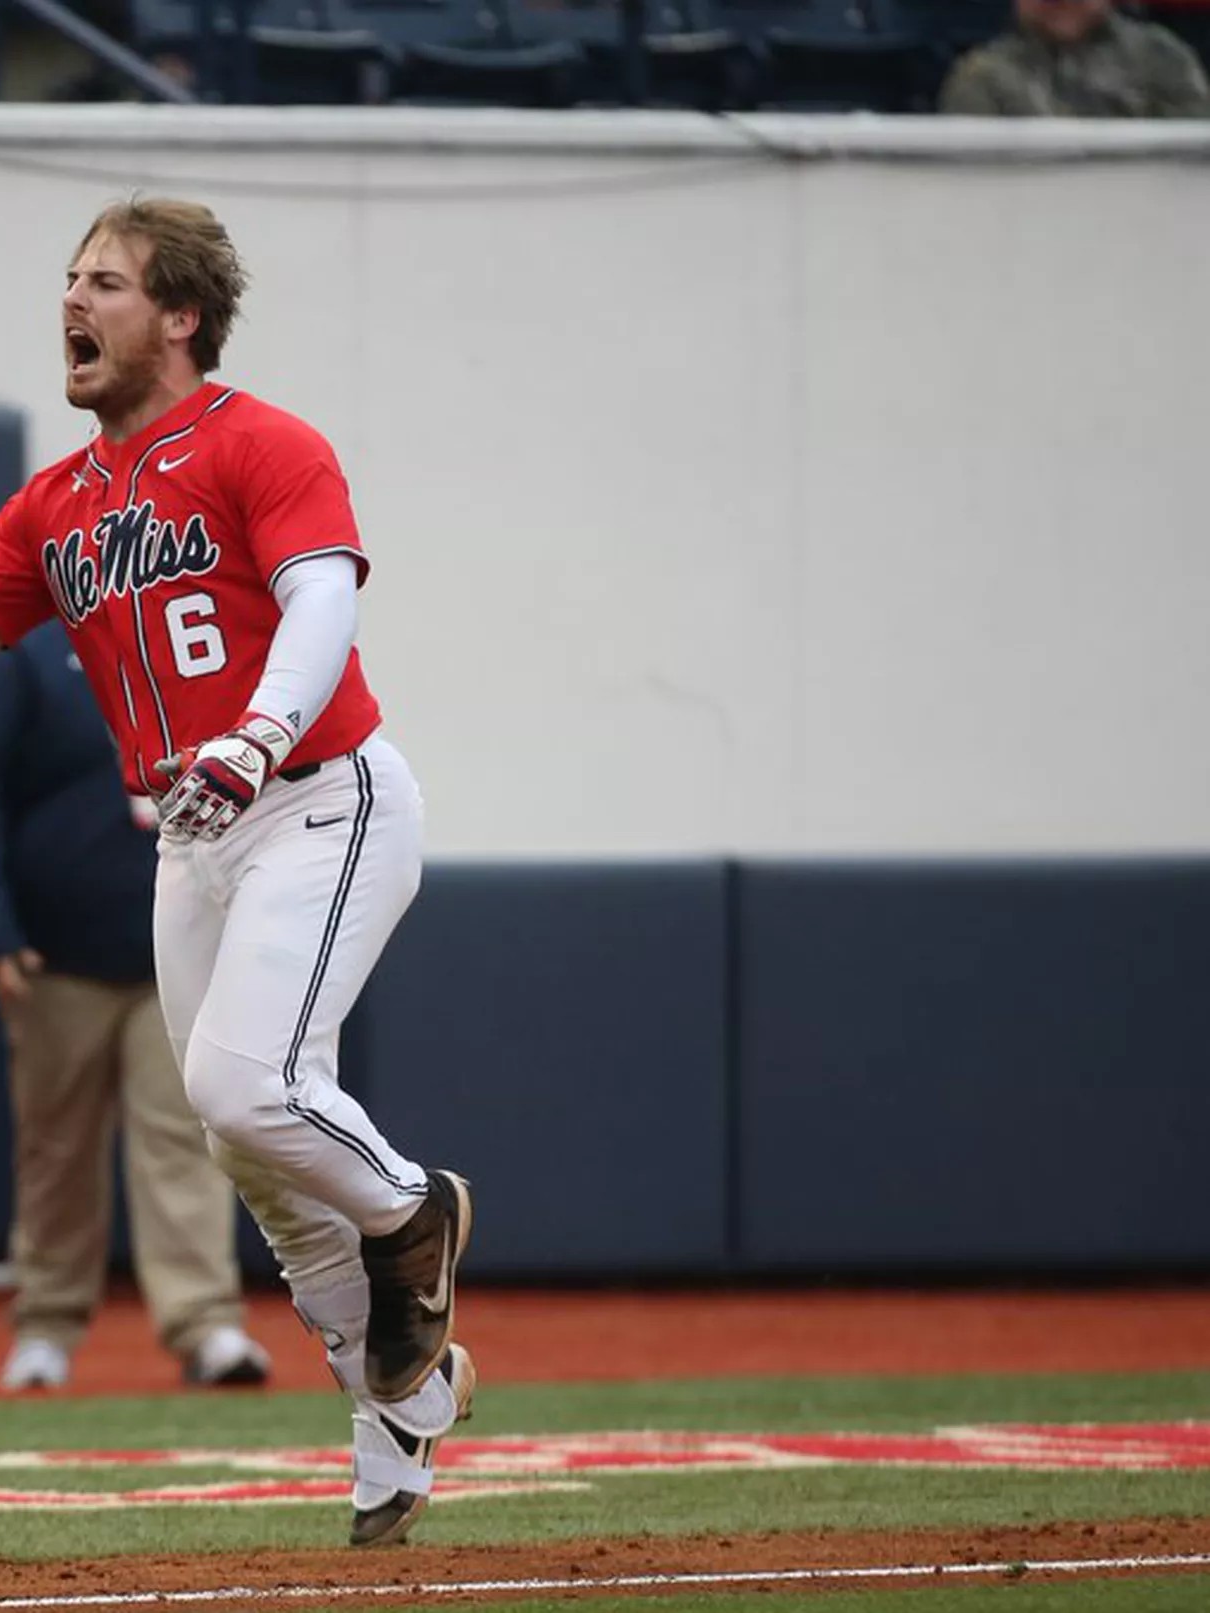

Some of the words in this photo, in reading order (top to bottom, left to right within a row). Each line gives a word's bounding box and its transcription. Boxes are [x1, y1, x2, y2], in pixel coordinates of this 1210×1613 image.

[43, 528, 100, 629] Ole
[91, 499, 221, 599] Miss
[164, 591, 228, 679] 6
